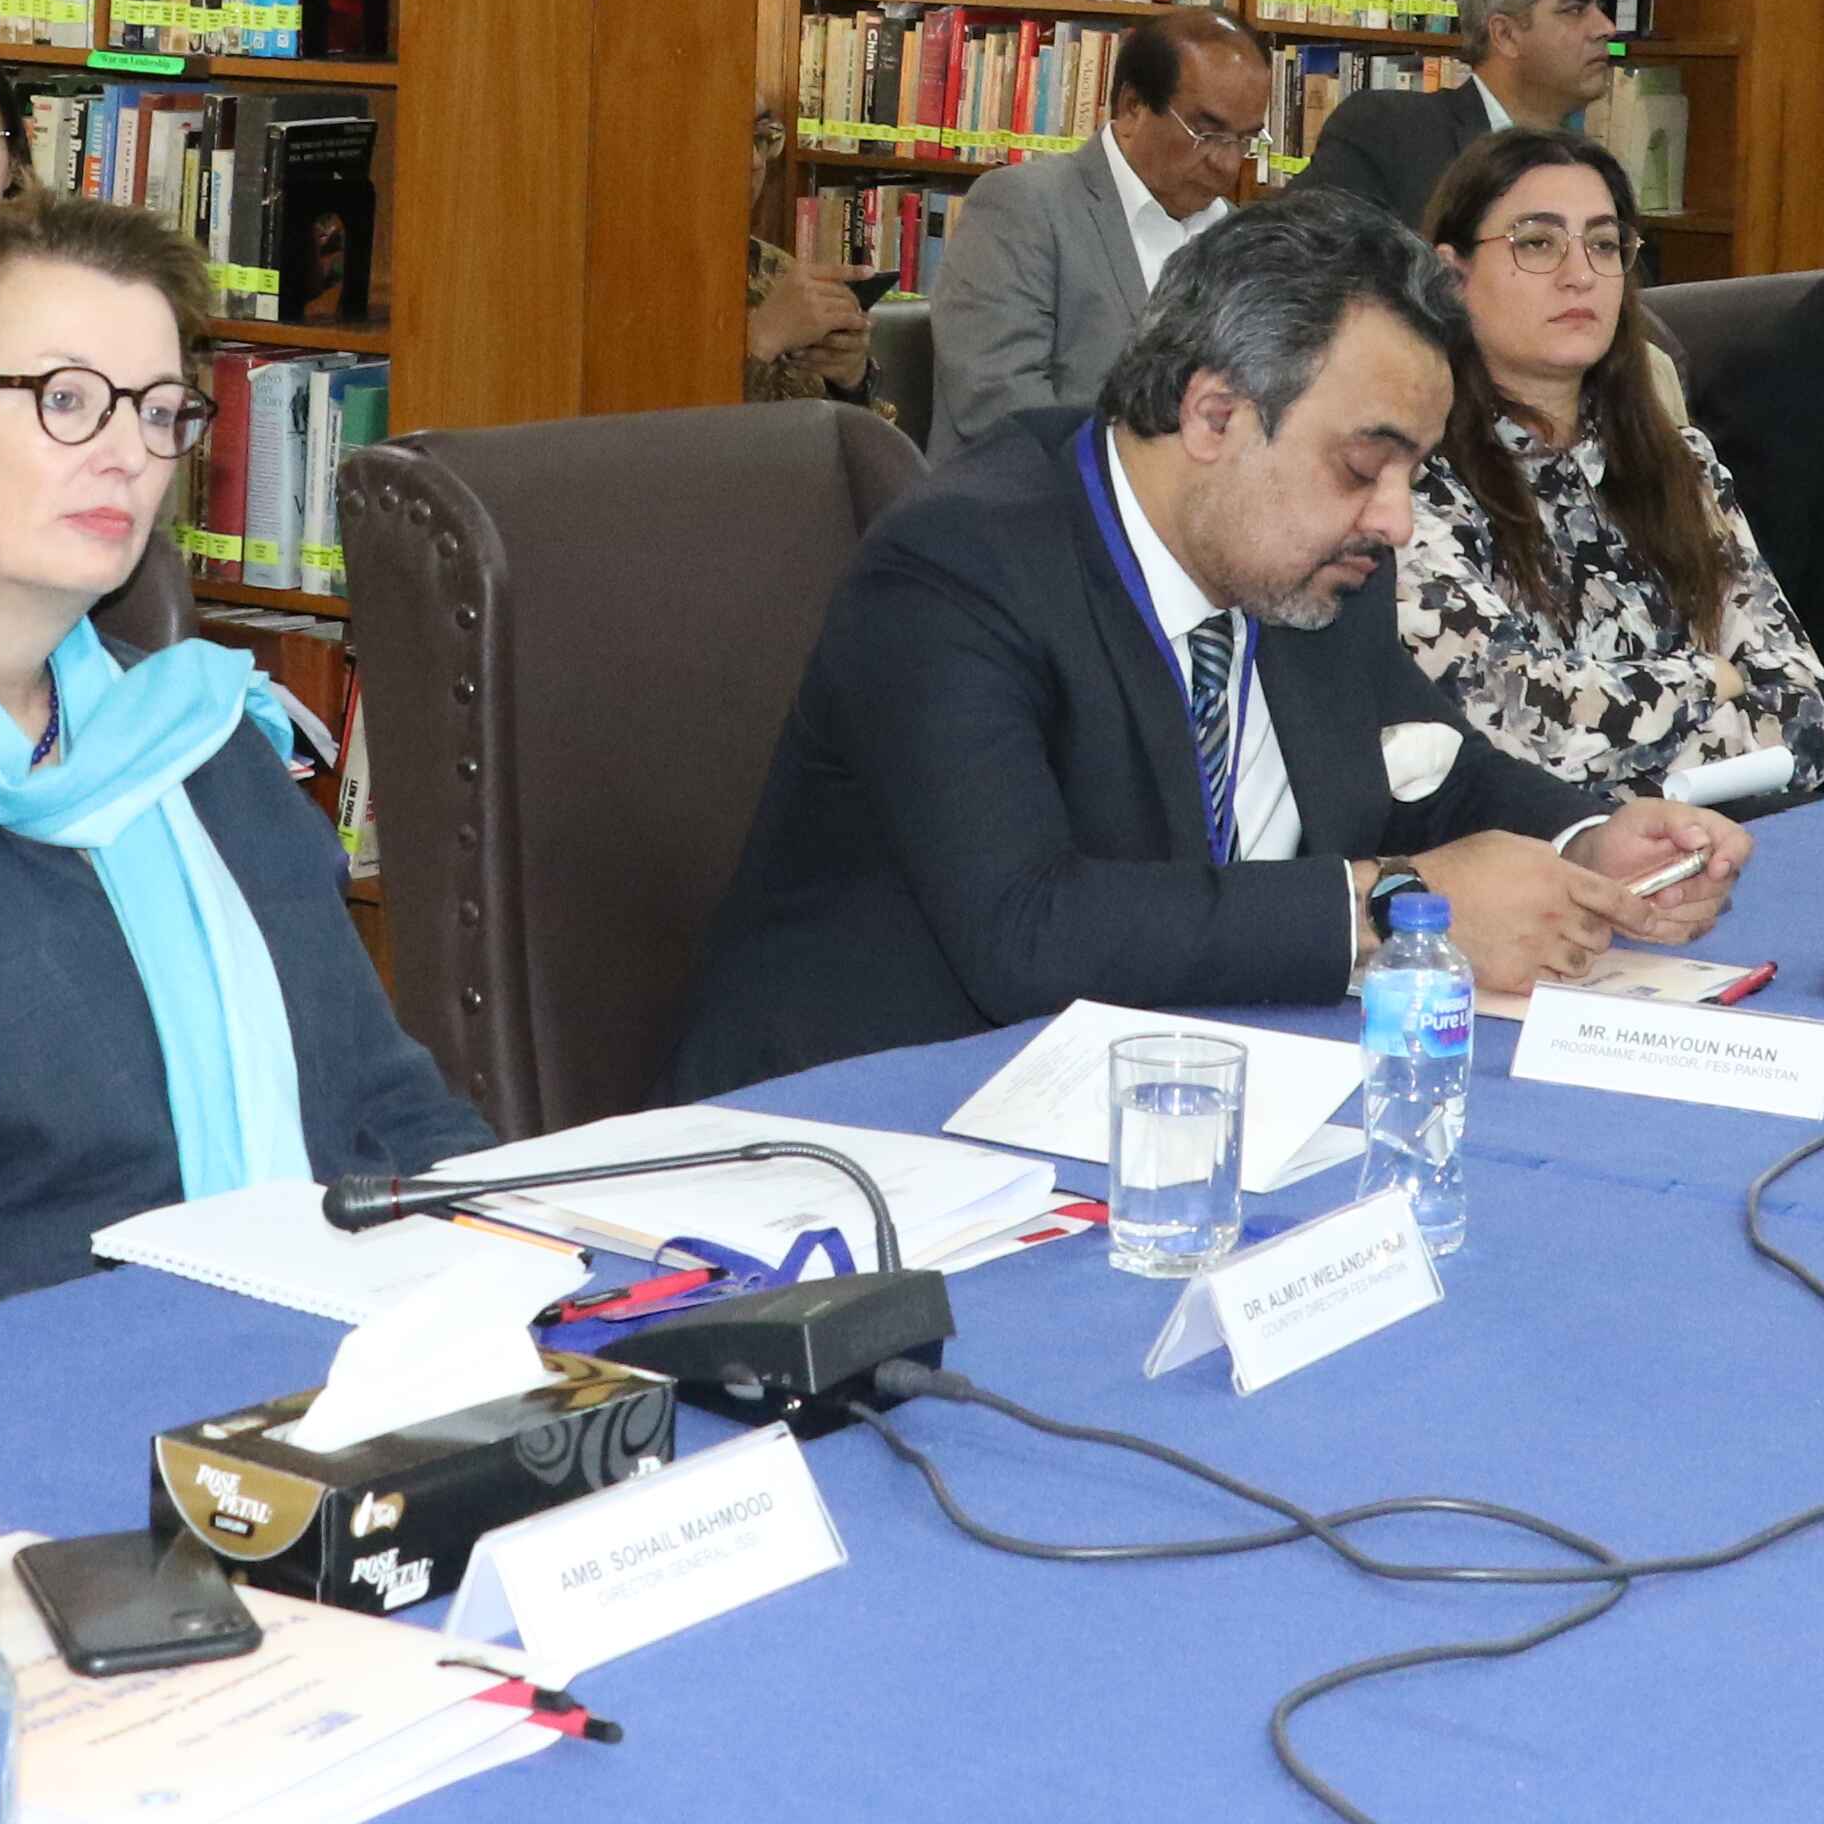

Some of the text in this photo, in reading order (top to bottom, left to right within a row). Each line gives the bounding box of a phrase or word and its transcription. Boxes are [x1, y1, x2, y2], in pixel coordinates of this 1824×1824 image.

[866, 28, 878, 71] China
[348, 779, 359, 799] LEN
[1419, 1012, 1460, 1032] Pure
[1549, 1038, 1636, 1062] PROGRAMME
[1704, 1059, 1730, 1074] FES
[1732, 1062, 1800, 1084] PAKISTAN
[1578, 1023, 1779, 1063] MR. HAMAYOUN KHAN
[1243, 1299, 1269, 1322] DR.
[1268, 1276, 1313, 1311] ALMUT
[194, 1463, 240, 1499] ROSE
[215, 1490, 273, 1526] PETAL
[609, 1530, 680, 1574] SOHAIL
[680, 1490, 774, 1542] MAHMOOD
[349, 1547, 401, 1585] ROSE
[375, 1558, 433, 1595] PETAL
